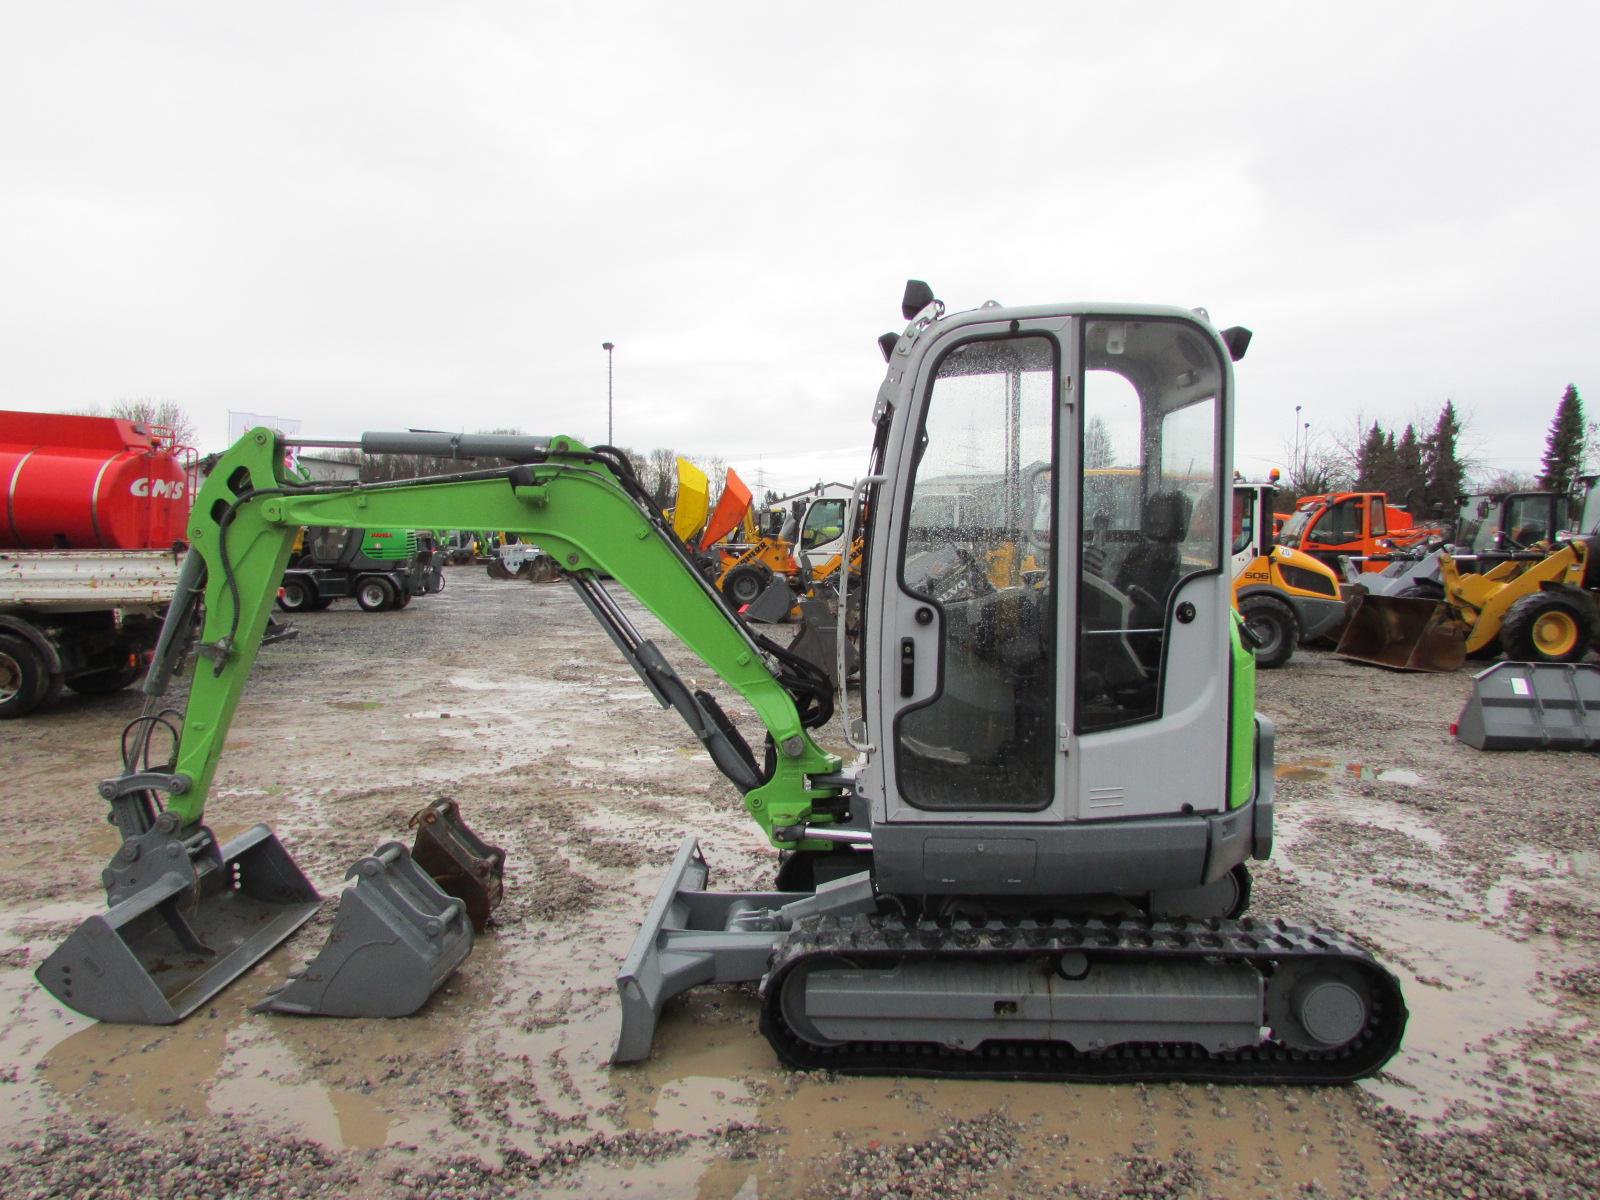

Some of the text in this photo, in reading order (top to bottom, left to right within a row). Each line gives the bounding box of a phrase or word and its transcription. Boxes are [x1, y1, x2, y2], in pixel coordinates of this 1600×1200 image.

[130, 478, 185, 499] GMS
[1280, 547, 1290, 556] 20
[937, 580, 967, 602] LVO
